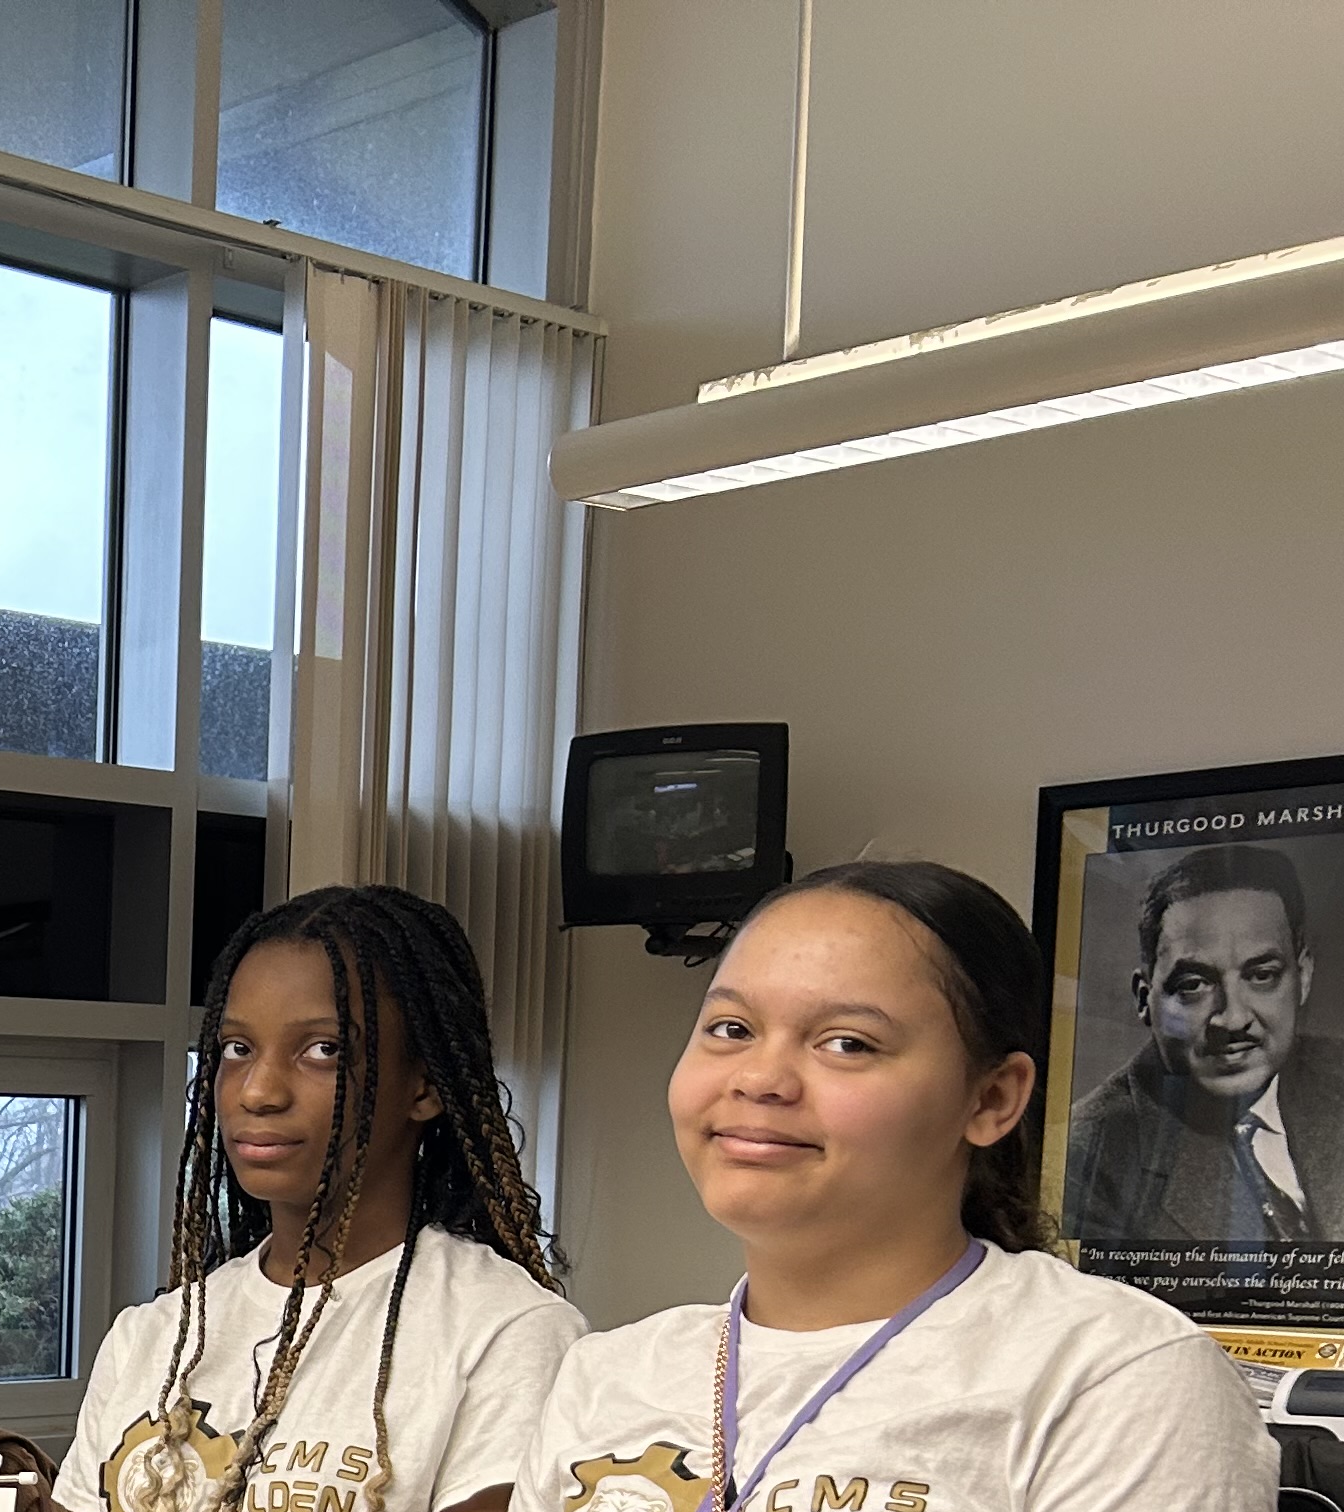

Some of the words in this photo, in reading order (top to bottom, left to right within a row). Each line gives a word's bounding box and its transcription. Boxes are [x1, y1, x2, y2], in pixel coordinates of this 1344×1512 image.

[1111, 813, 1245, 839] THURGOOD
[1108, 1248, 1181, 1267] recognizing
[1185, 1246, 1206, 1262] the
[1210, 1247, 1278, 1268] humanity
[1282, 1248, 1300, 1270] of
[1300, 1252, 1325, 1264] our
[1133, 1274, 1150, 1285] we
[1153, 1276, 1179, 1292] pay
[1182, 1272, 1240, 1287] ourselves
[1244, 1272, 1265, 1288] the
[1269, 1272, 1319, 1294] highest
[1250, 1311, 1286, 1321] American
[1234, 1346, 1253, 1357] IN
[1254, 1346, 1306, 1360] ACTION
